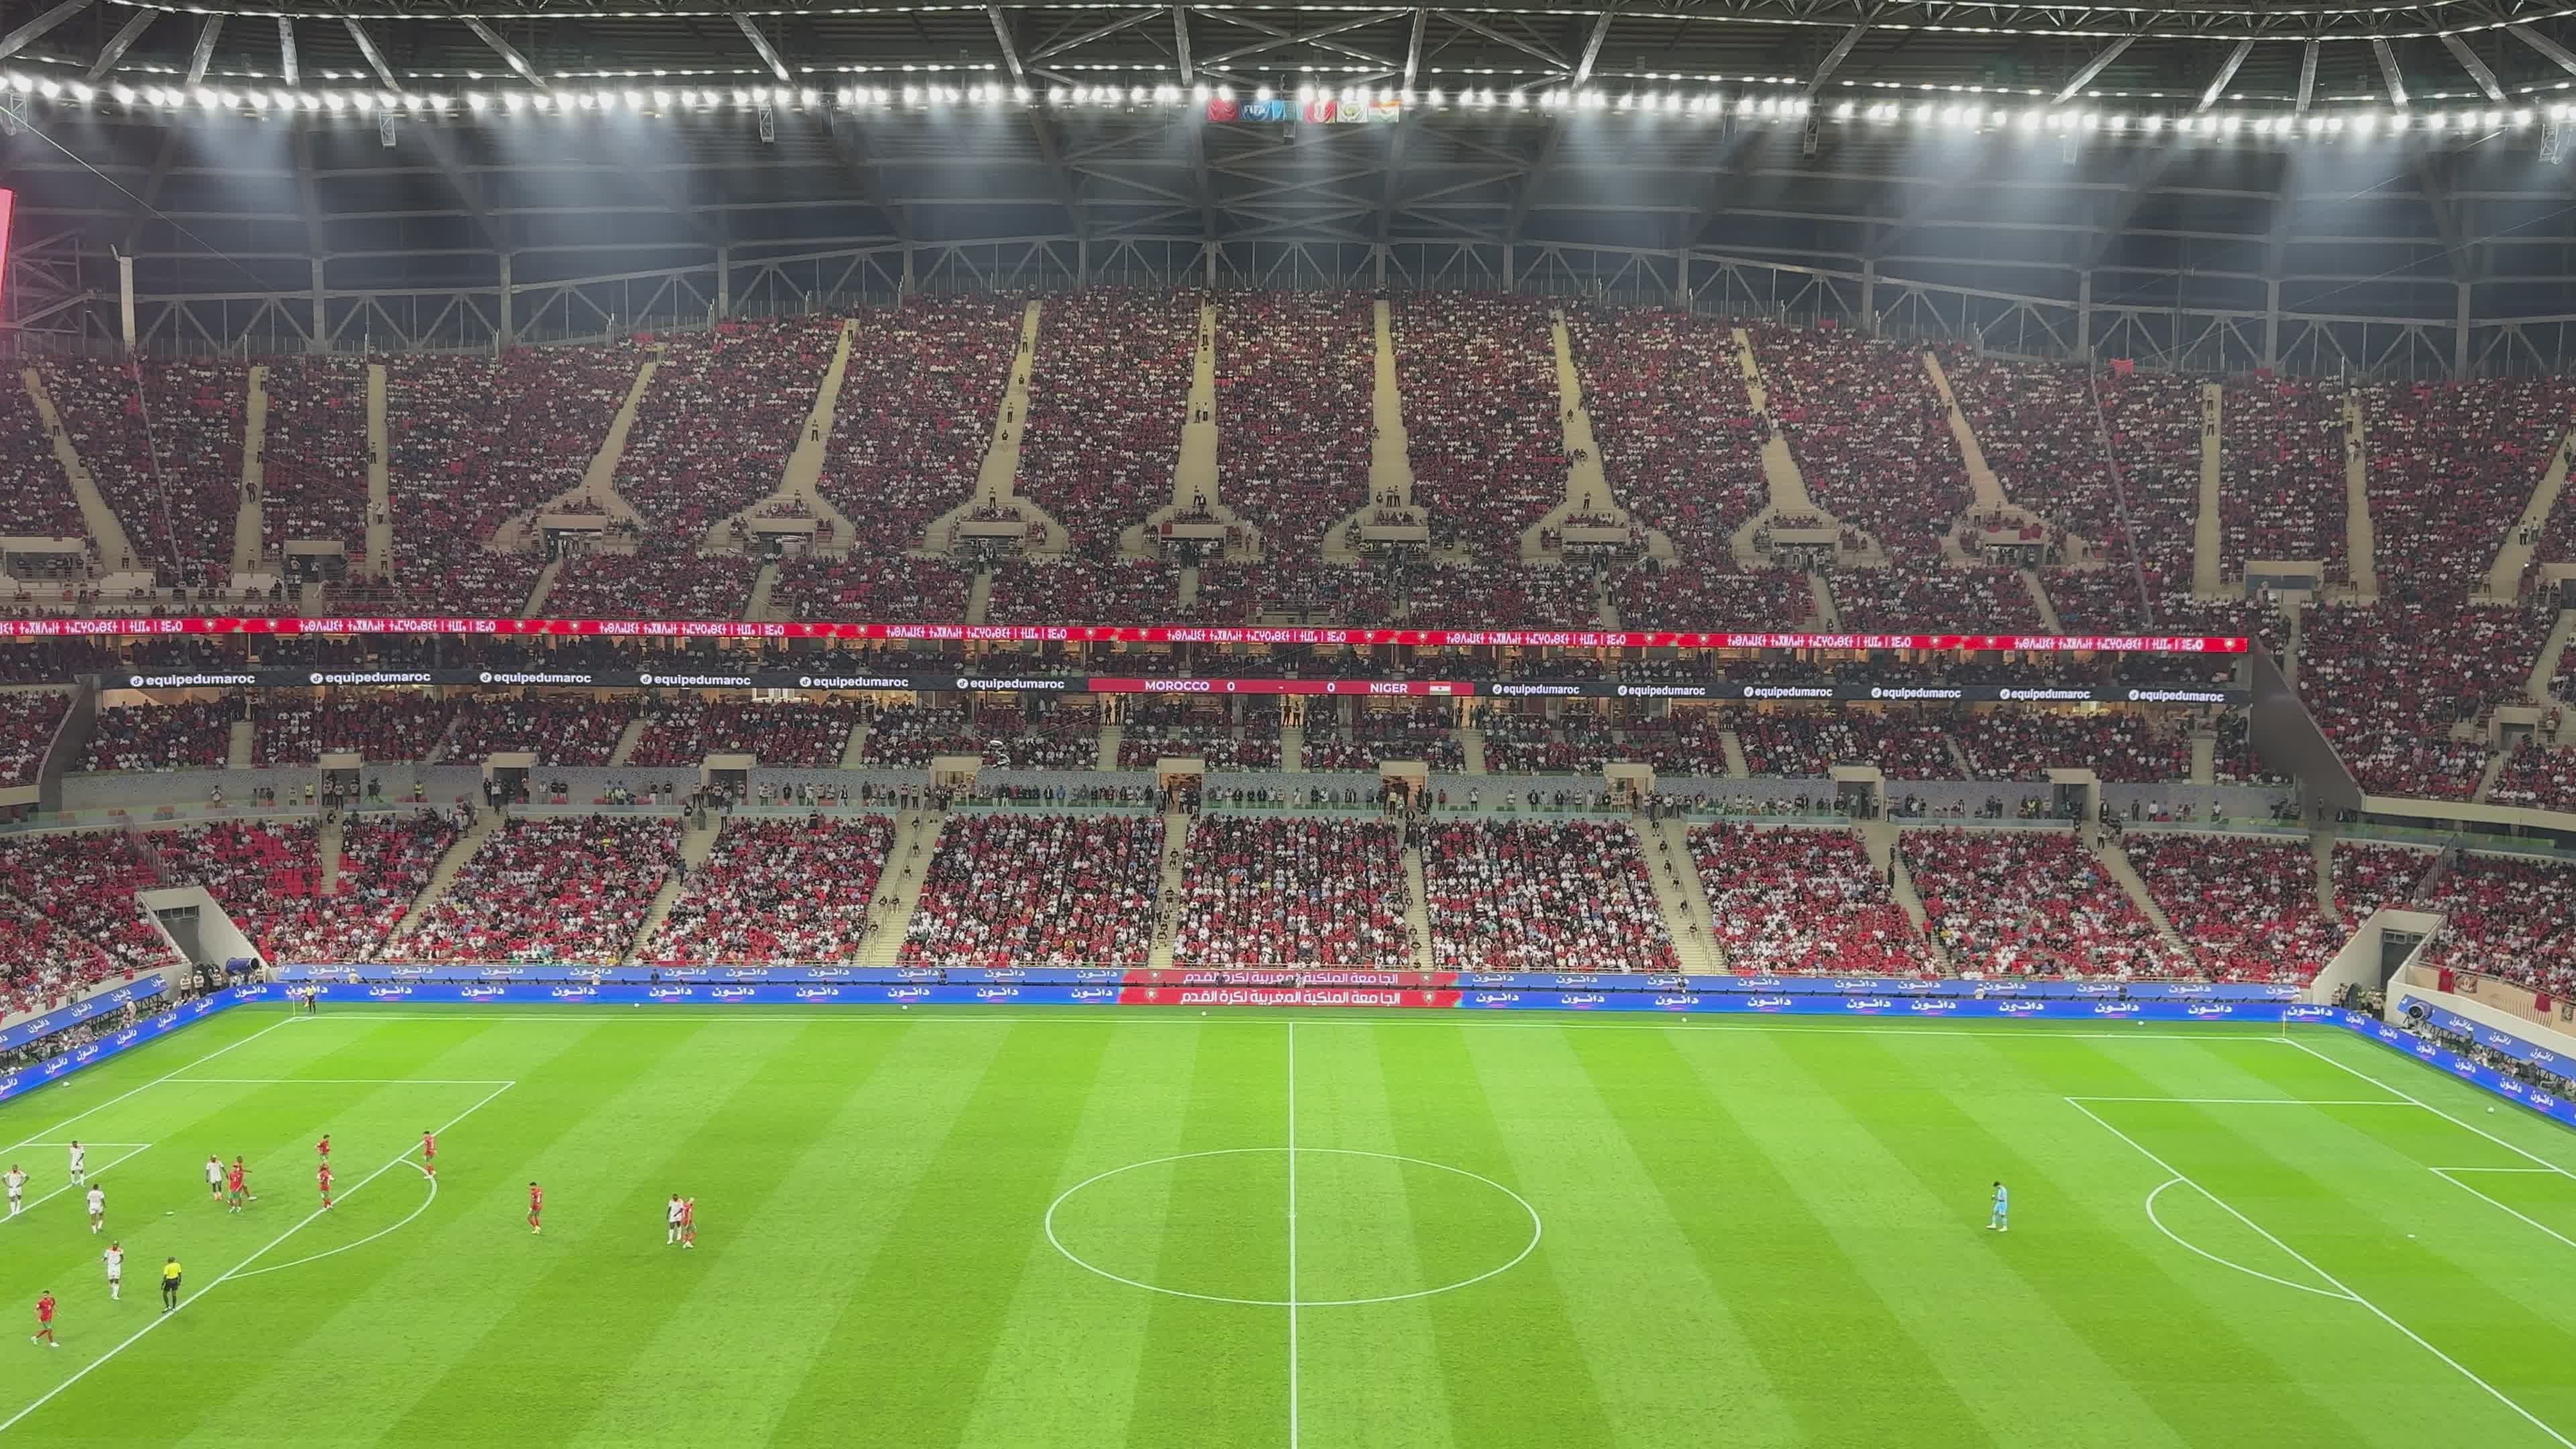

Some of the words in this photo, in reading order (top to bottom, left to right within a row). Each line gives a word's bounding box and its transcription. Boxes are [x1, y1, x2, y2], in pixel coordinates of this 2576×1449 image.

[1244, 105, 1266, 115] FIFA
[146, 674, 255, 687] equipedumaroc
[326, 672, 431, 684] equipedumaroc
[494, 673, 591, 684] equipedumaroc
[655, 674, 751, 686] equipedumaroc
[814, 676, 908, 688] equipedumaroc
[971, 678, 1064, 690] equipedumaroc
[1146, 681, 1209, 691] MOROCCO
[1228, 682, 1234, 691] 0
[1328, 683, 1335, 692] 0
[1371, 684, 1407, 693] NIGER
[1504, 686, 1579, 696] equipedumaroc
[1628, 686, 1705, 697] equipedumaroc
[1755, 687, 1833, 698] equipedumaroc
[1882, 688, 1961, 699] equipedumaroc
[2012, 689, 2091, 701] equipedumaroc
[2140, 690, 2224, 703] equipedumaroc
[370, 986, 412, 998] دانون
[462, 987, 504, 998] دانون
[553, 987, 595, 996] دانون
[649, 987, 692, 996] دانون
[712, 987, 754, 996] دانون
[796, 987, 838, 997] دانون
[889, 987, 929, 997] دانون
[977, 987, 1018, 997] دانون
[1072, 989, 1112, 998] دانون
[1250, 989, 1301, 1005] المغربية
[1181, 990, 1217, 1005] القدم
[1220, 990, 1247, 1005] لكرة
[1304, 990, 1348, 1005] الملكية
[1477, 993, 1519, 1003] دانون
[1562, 995, 1604, 1004] دانون
[1656, 996, 1698, 1005] دانون
[1748, 998, 1791, 1006] دانون
[1847, 999, 1890, 1008] دانون
[1912, 1000, 1955, 1010] دانون
[2000, 1002, 2043, 1012] دانون
[2095, 1004, 2139, 1013] دانون
[2189, 1005, 2231, 1014] دانون
[2288, 1005, 2332, 1016] دانون
